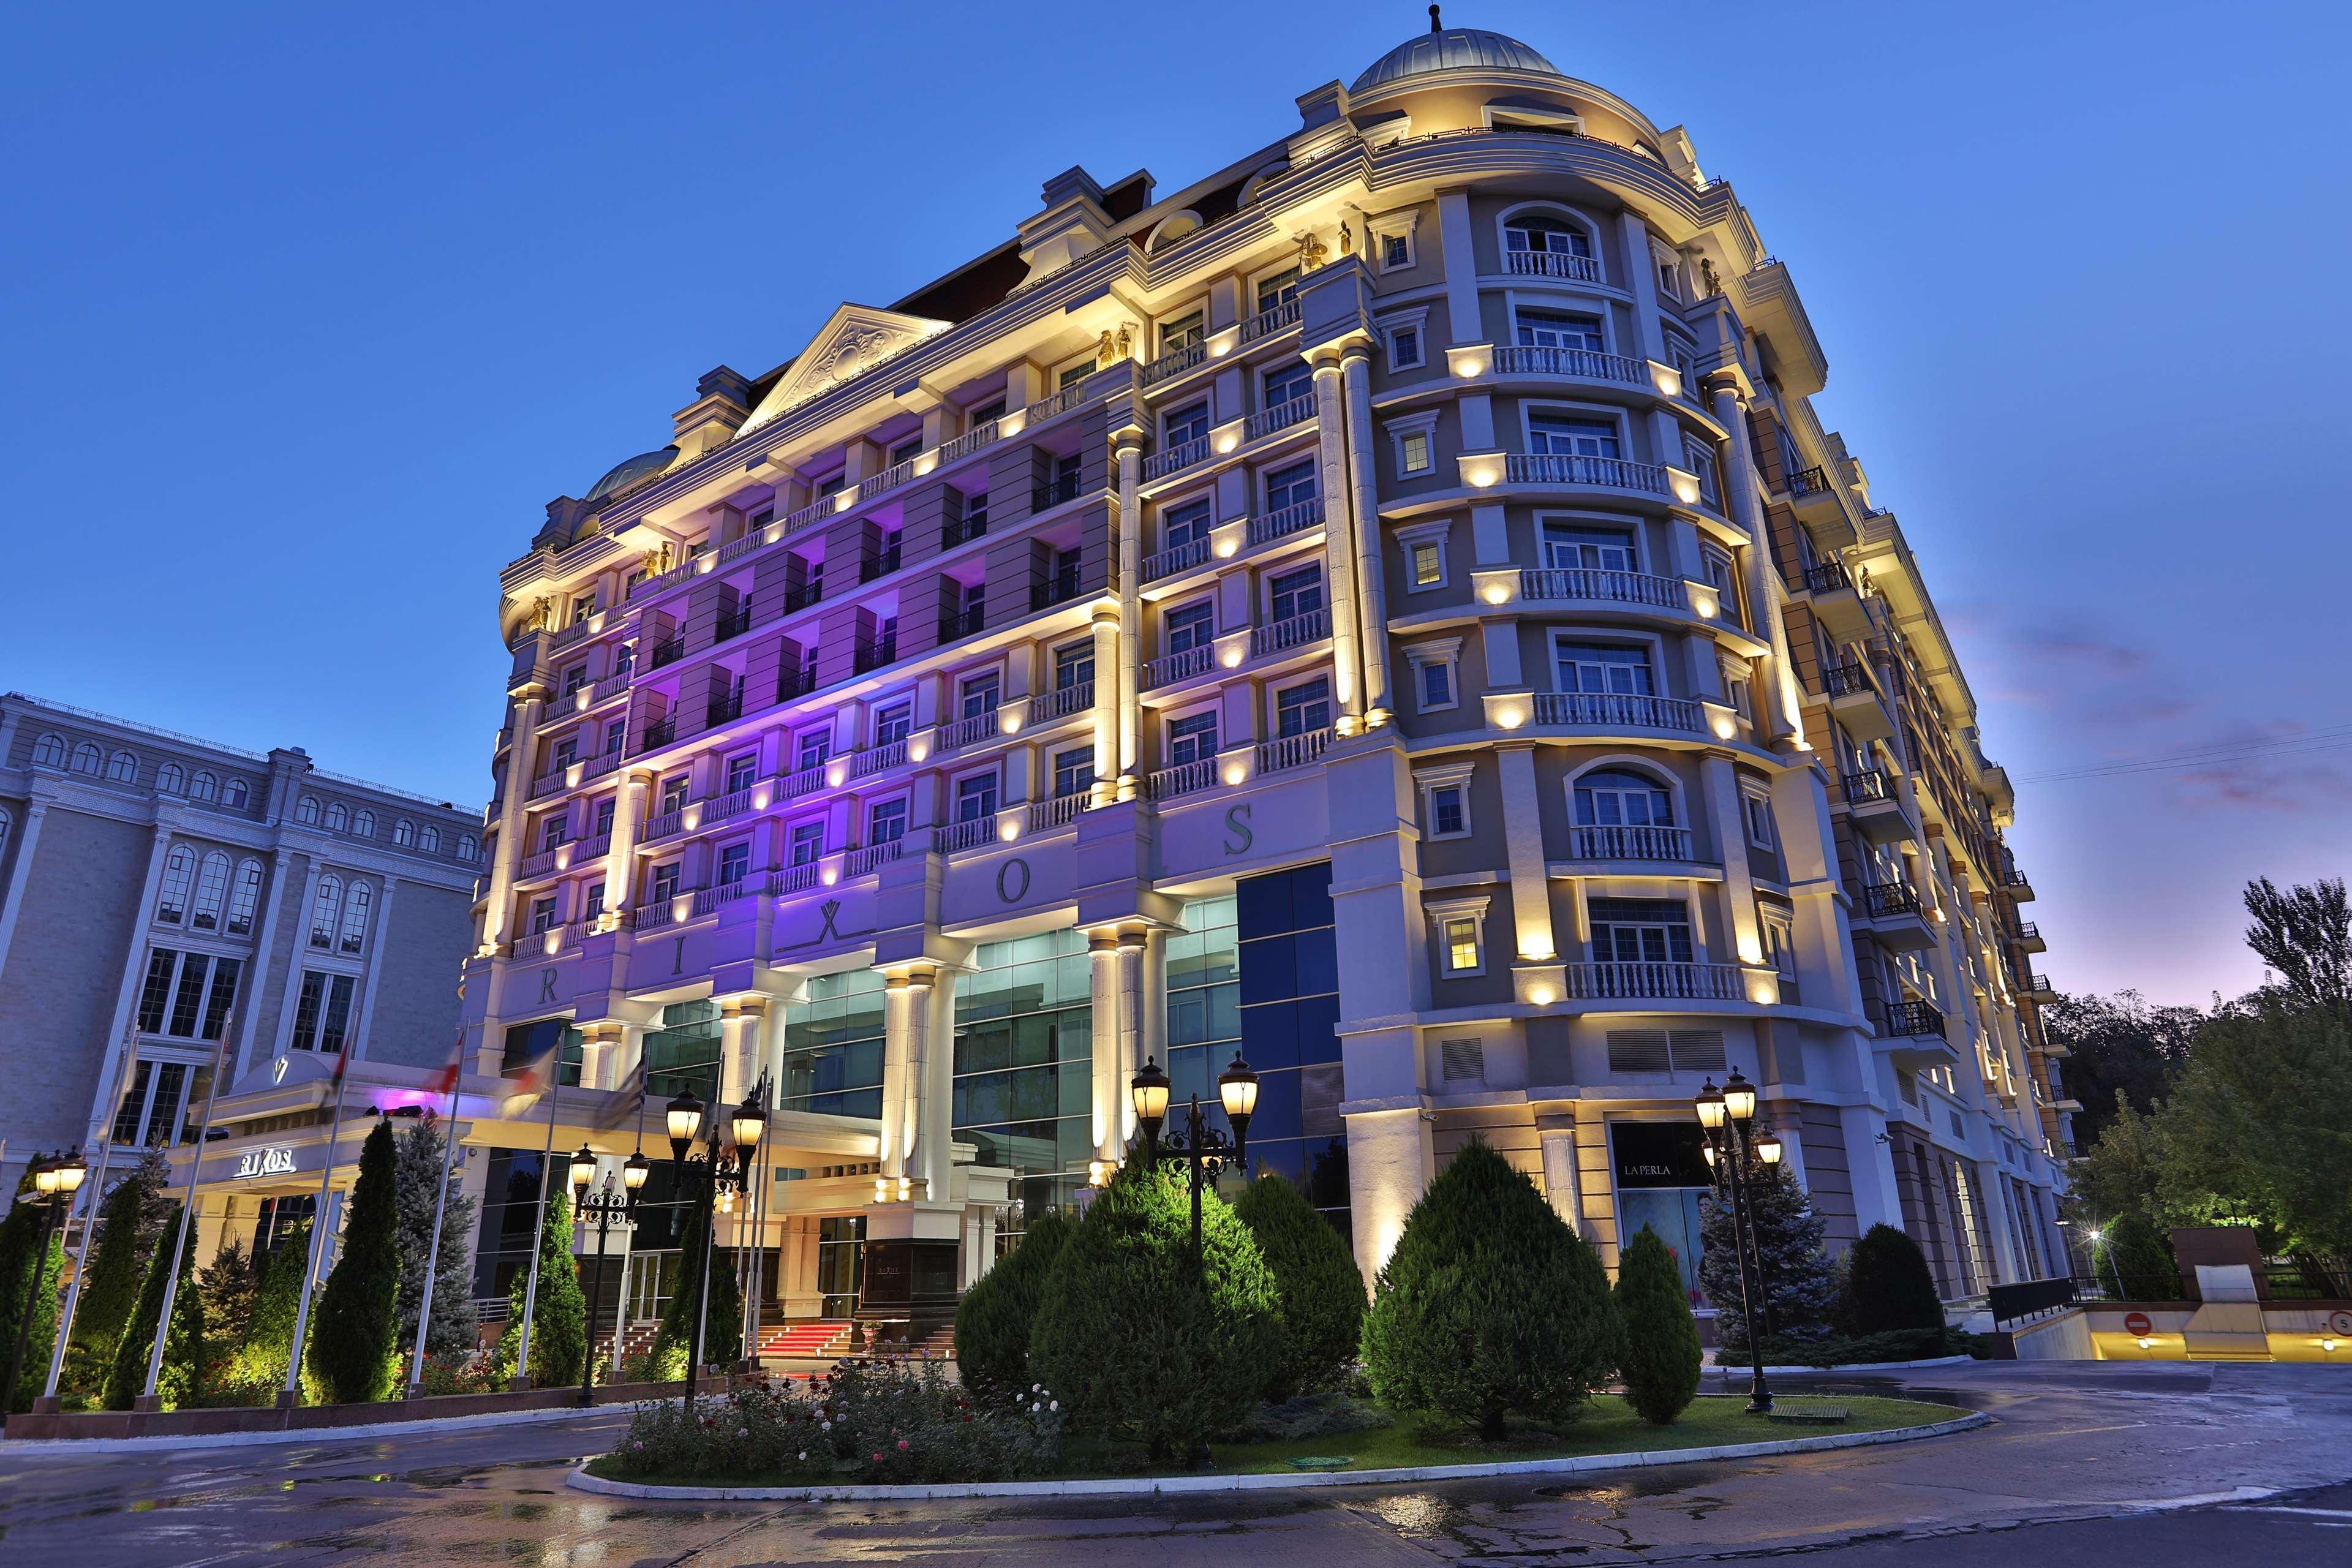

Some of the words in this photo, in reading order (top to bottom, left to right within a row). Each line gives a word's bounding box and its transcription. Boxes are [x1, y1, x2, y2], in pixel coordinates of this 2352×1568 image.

[538, 803, 1253, 1005] RIXOS
[233, 1148, 296, 1178] RIXOS
[1624, 1166, 1638, 1175] LA
[1640, 1166, 1671, 1175] PERLA
[2340, 1319, 2348, 1329] 5
